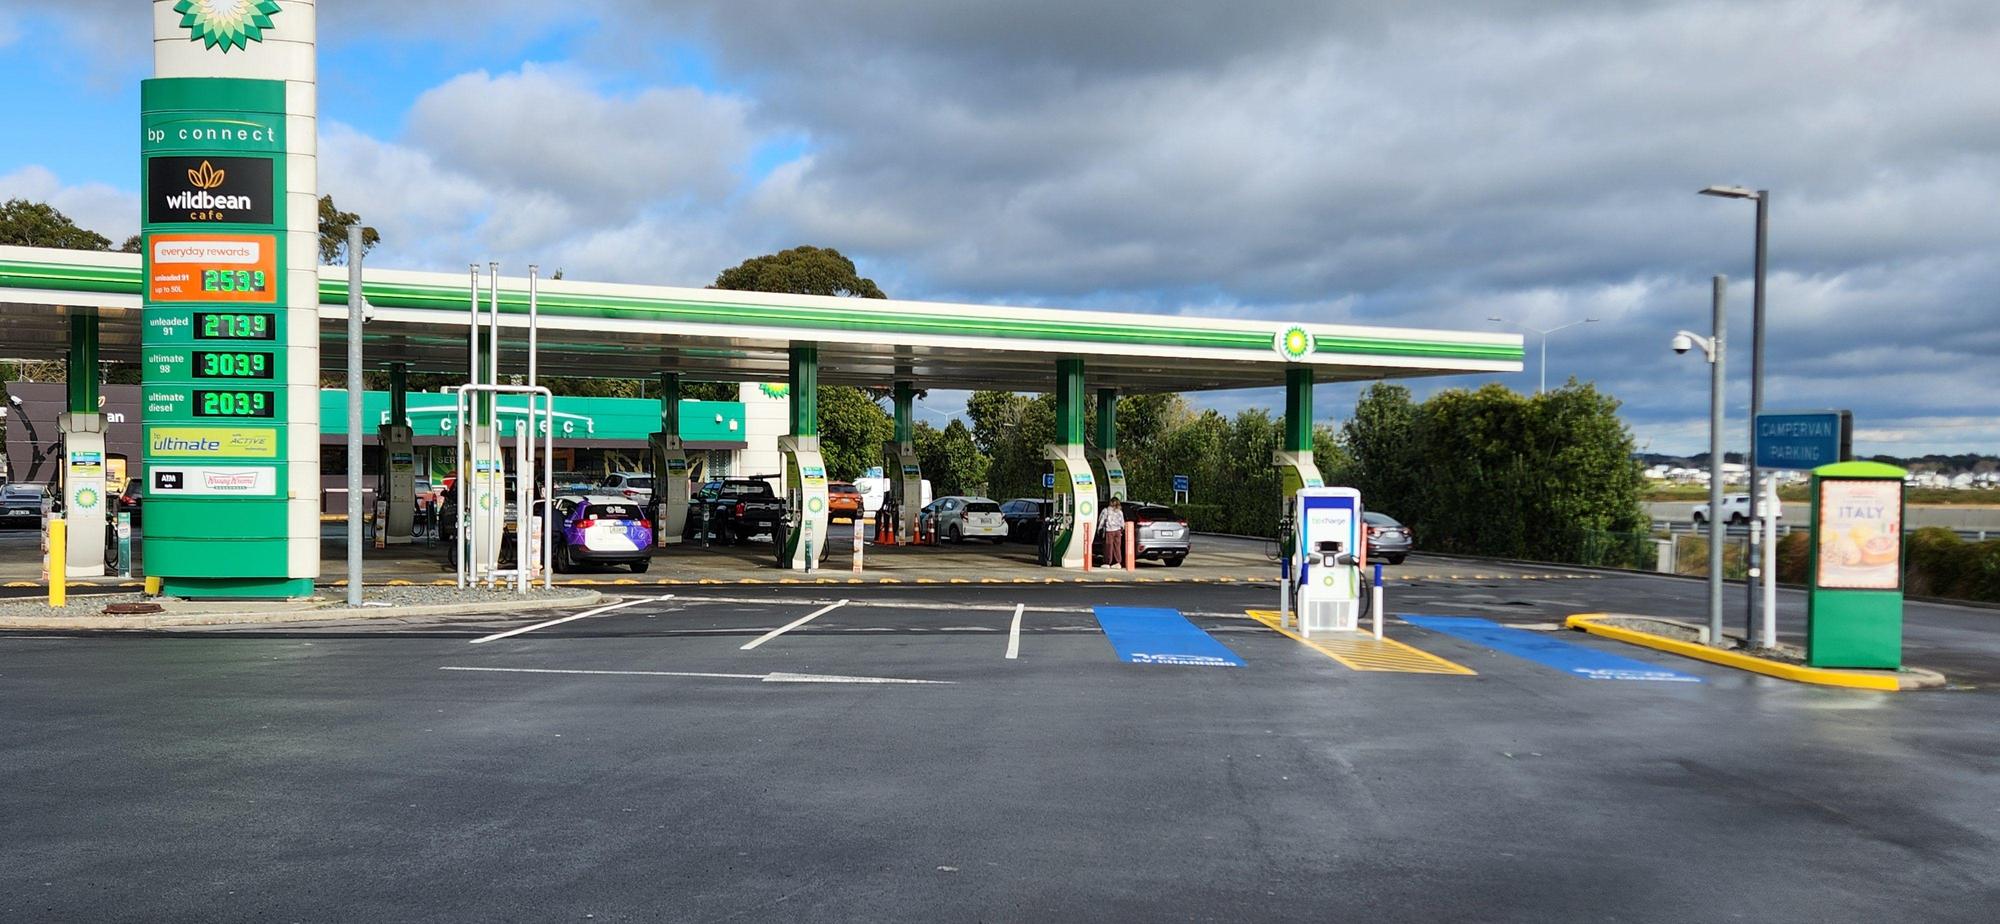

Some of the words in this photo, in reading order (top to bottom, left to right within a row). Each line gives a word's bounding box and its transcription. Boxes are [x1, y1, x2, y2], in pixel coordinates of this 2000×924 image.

[148, 128, 165, 143] bp
[179, 127, 275, 142] connect
[166, 191, 251, 210] wildbean
[190, 210, 223, 220] cafe
[161, 247, 205, 257] everyday
[206, 247, 250, 257] rewards
[155, 273, 181, 282] unleaded
[181, 274, 189, 282] 91
[205, 269, 265, 291] 253.9
[150, 317, 189, 326] unleaded
[205, 314, 265, 336] 273.9
[163, 327, 173, 336] 91
[148, 354, 184, 363] ultimate
[160, 365, 171, 374] 98
[204, 353, 264, 376] 303.9
[148, 392, 185, 402] ultimate
[148, 403, 173, 412] diesel
[204, 392, 264, 415] 203.9
[1761, 421, 1832, 437] CAMPERVAN
[153, 437, 220, 451] ultimate
[1770, 445, 1820, 461] PARKING
[161, 474, 176, 483] ATM
[1839, 506, 1884, 519] ITALY
